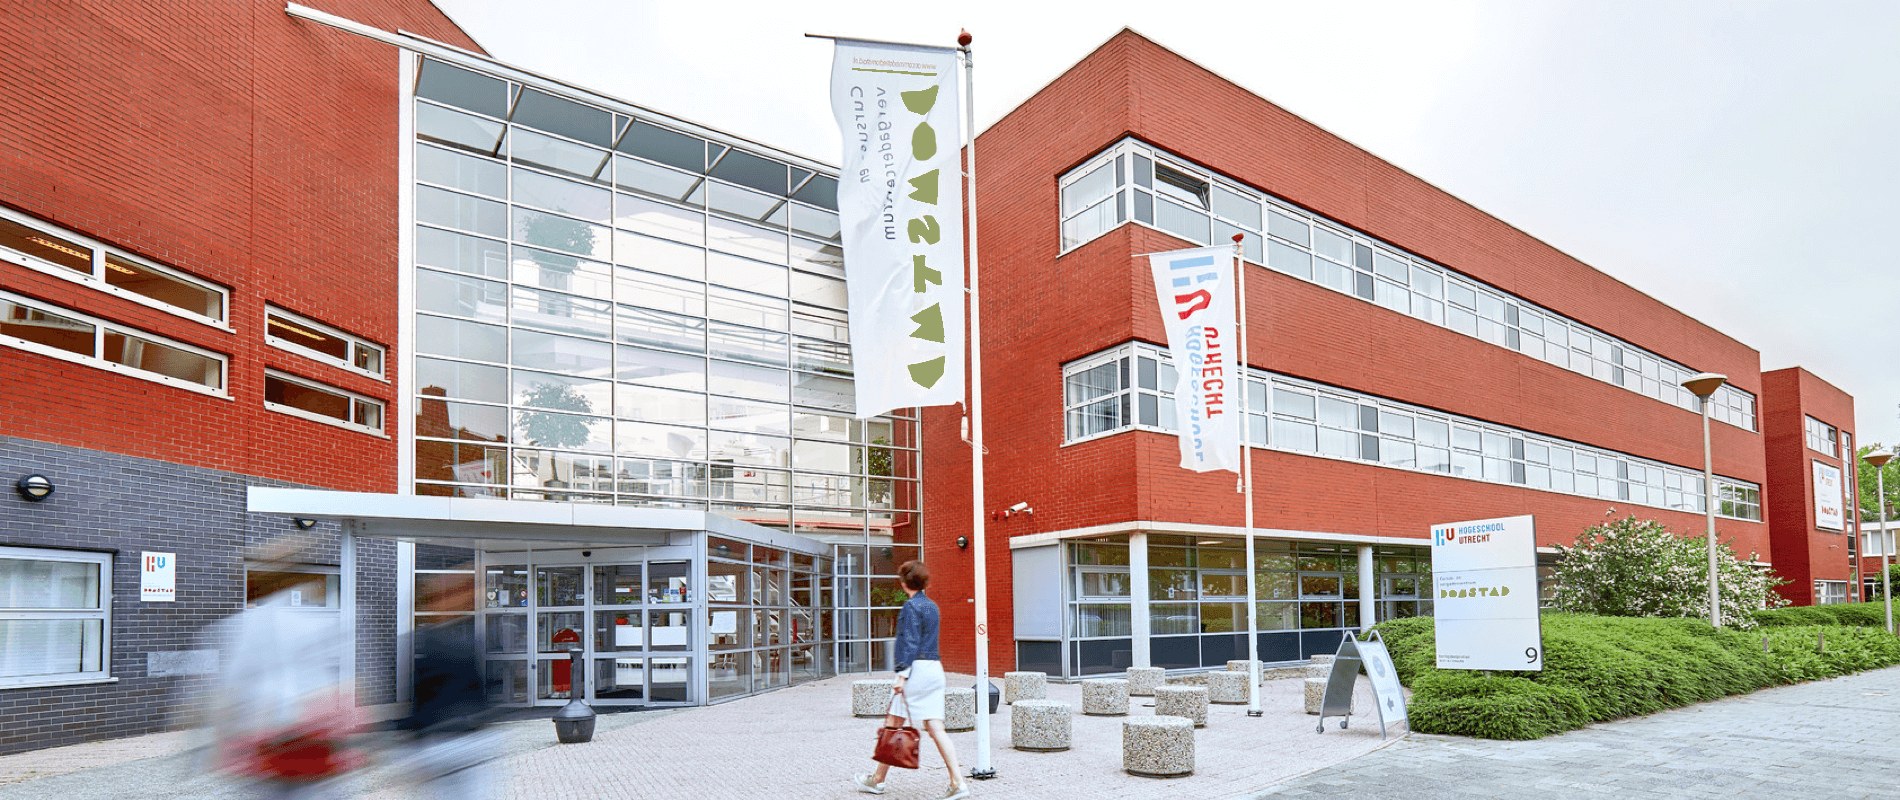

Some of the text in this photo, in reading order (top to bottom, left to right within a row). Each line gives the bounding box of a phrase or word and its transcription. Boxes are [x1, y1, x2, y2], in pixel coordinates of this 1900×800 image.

[1459, 523, 1505, 534] HOGESCHOOL
[1459, 534, 1490, 545] UTRECHT
[1440, 586, 1510, 599] DOMSTAD
[1525, 647, 1538, 664] 9
